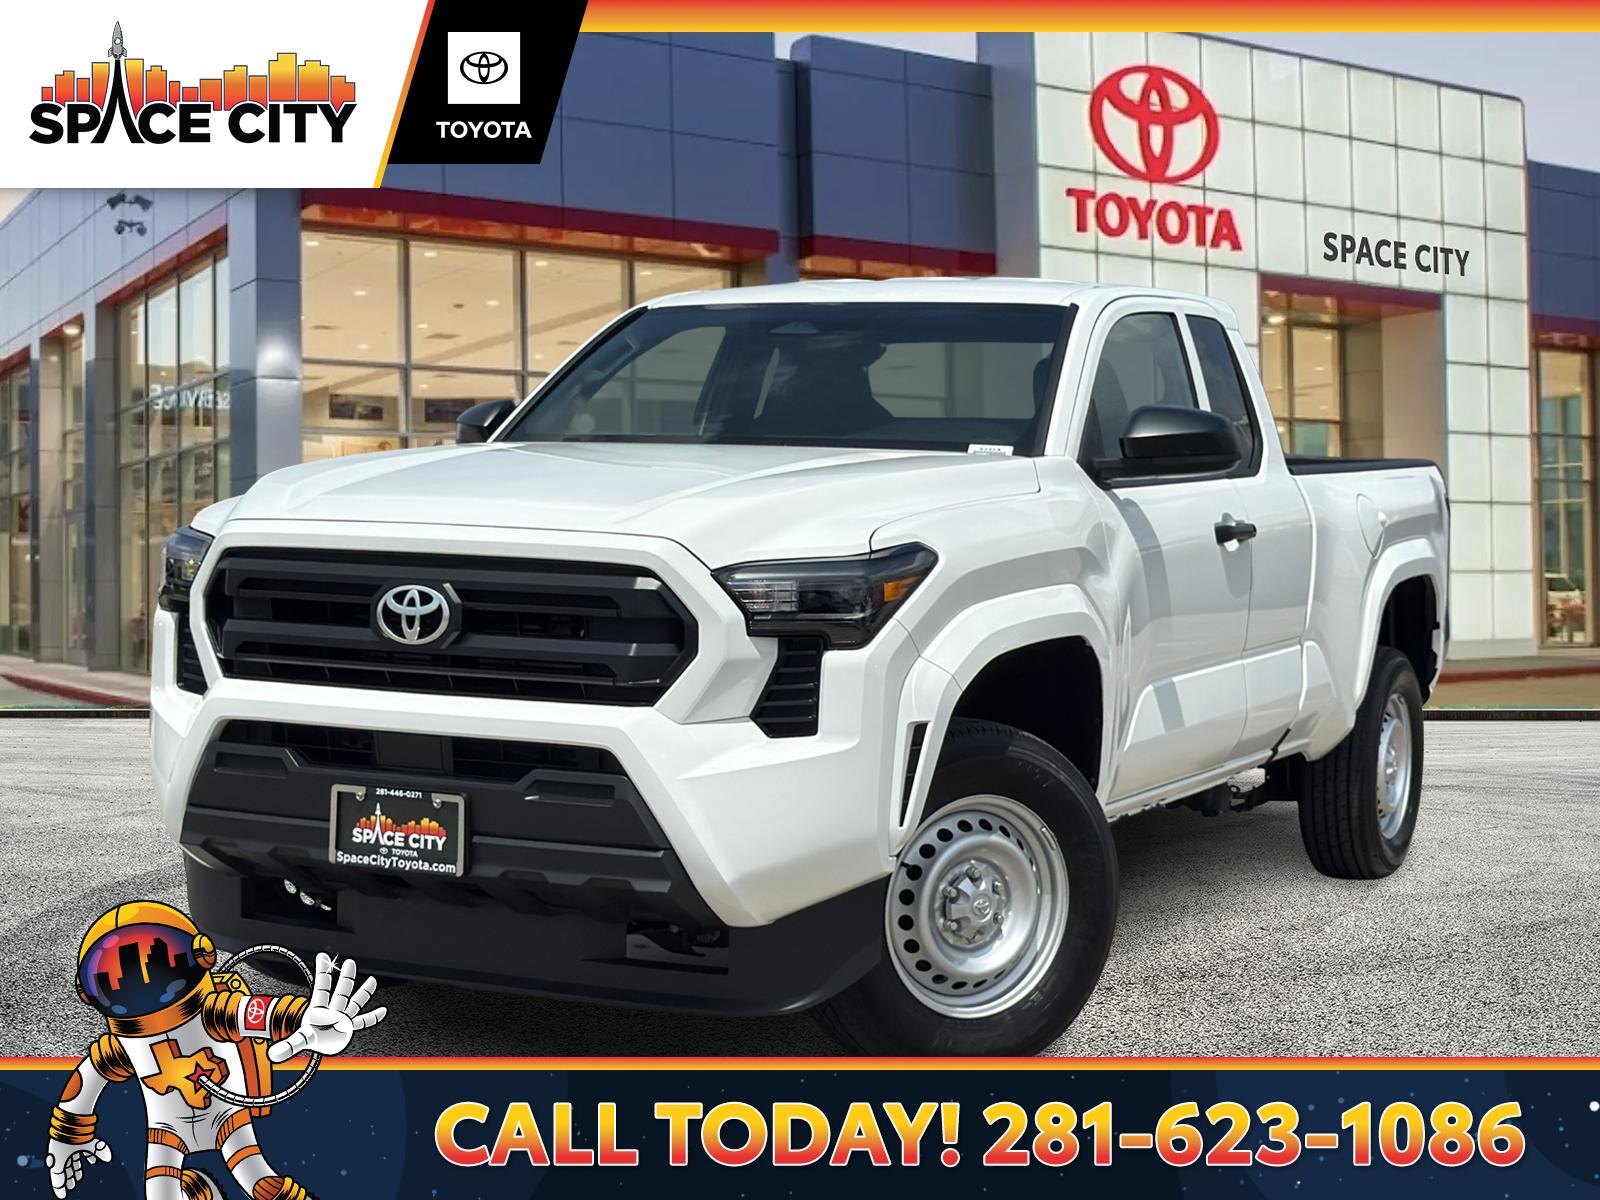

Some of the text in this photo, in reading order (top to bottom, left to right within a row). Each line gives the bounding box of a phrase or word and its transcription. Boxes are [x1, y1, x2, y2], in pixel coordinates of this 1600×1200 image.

[1066, 187, 1243, 252] TOYOTA
[1323, 231, 1471, 277] SPACE CITY
[352, 821, 447, 851] SPACE CITY
[336, 851, 457, 874] SpaceCityToyota.com
[391, 848, 418, 858] TOYOTA
